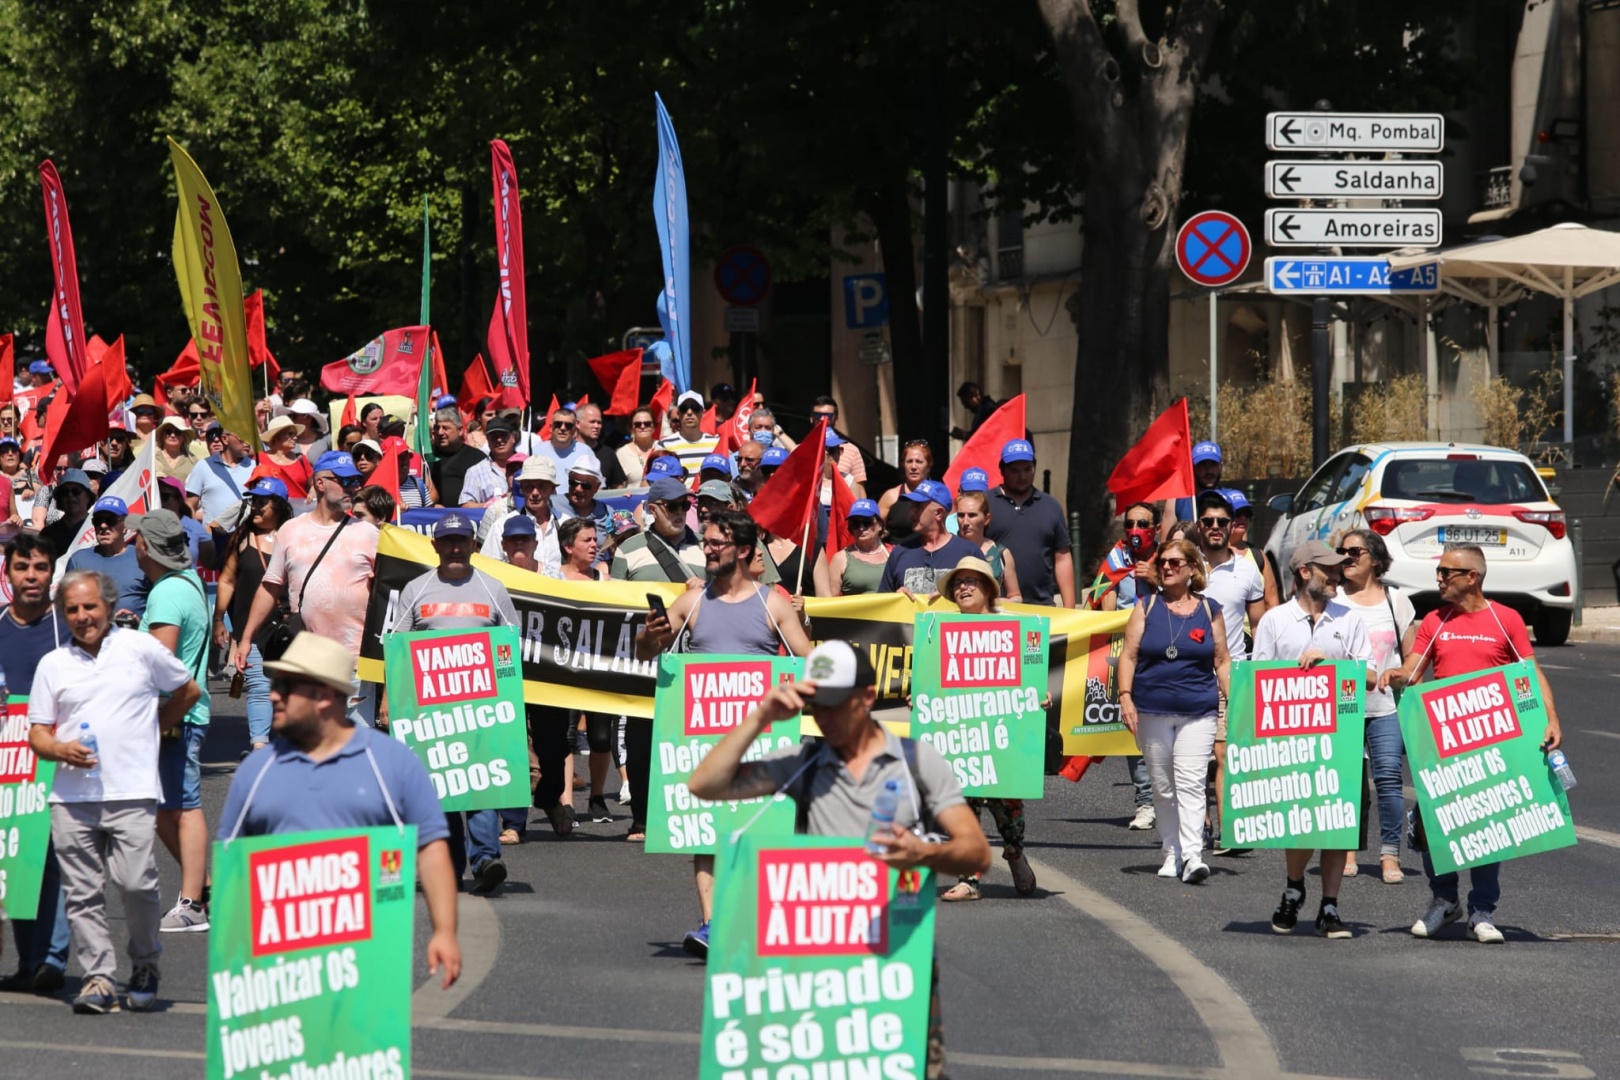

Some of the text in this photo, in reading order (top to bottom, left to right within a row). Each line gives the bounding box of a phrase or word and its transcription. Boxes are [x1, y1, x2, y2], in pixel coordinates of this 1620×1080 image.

[1330, 123, 1436, 141] Mq. Pombal
[1334, 170, 1435, 189] Saldanha
[1324, 219, 1434, 236] Amoreiras
[1328, 265, 1350, 284] A1
[1368, 265, 1393, 285] A2
[1410, 266, 1436, 286] A5
[1510, 547, 1526, 556] A11
[946, 630, 1013, 654] VAMOS
[1440, 631, 1498, 642] Champion
[416, 642, 486, 672] VAMOS
[946, 654, 960, 681] À
[964, 657, 1016, 680] LUTA!
[422, 670, 436, 699] À
[438, 668, 492, 697] LUTA!
[690, 672, 764, 698] VAMOS
[1260, 674, 1329, 702] VAMOS
[690, 698, 705, 728] À
[916, 687, 1040, 724] Segurança
[1261, 703, 1274, 731] À
[1279, 702, 1332, 729] LUTA!
[1429, 682, 1505, 724] VAMOS
[392, 701, 516, 745] Público
[994, 718, 1009, 750] é
[1441, 708, 1515, 751] À LUTA!
[426, 740, 468, 770] de
[1227, 736, 1316, 775] Combater
[1418, 747, 1507, 800] Valorizar os
[16, 779, 46, 816] dos
[1230, 764, 1340, 810] aumento do
[1434, 775, 1534, 836] professores e
[668, 812, 716, 849] SNS
[1234, 798, 1356, 844] custo de vida
[1449, 801, 1565, 866] a escola pública
[257, 850, 360, 902] VAMOS
[765, 861, 878, 902] VAMOS
[259, 893, 365, 946] À LUTA!
[765, 901, 881, 946] À LUTA!
[212, 947, 359, 1021] Valorizar os
[710, 958, 915, 1019] Privado
[220, 1015, 304, 1080] jovens
[715, 1019, 748, 1068] é
[758, 1011, 824, 1063] só
[835, 1008, 904, 1056] de
